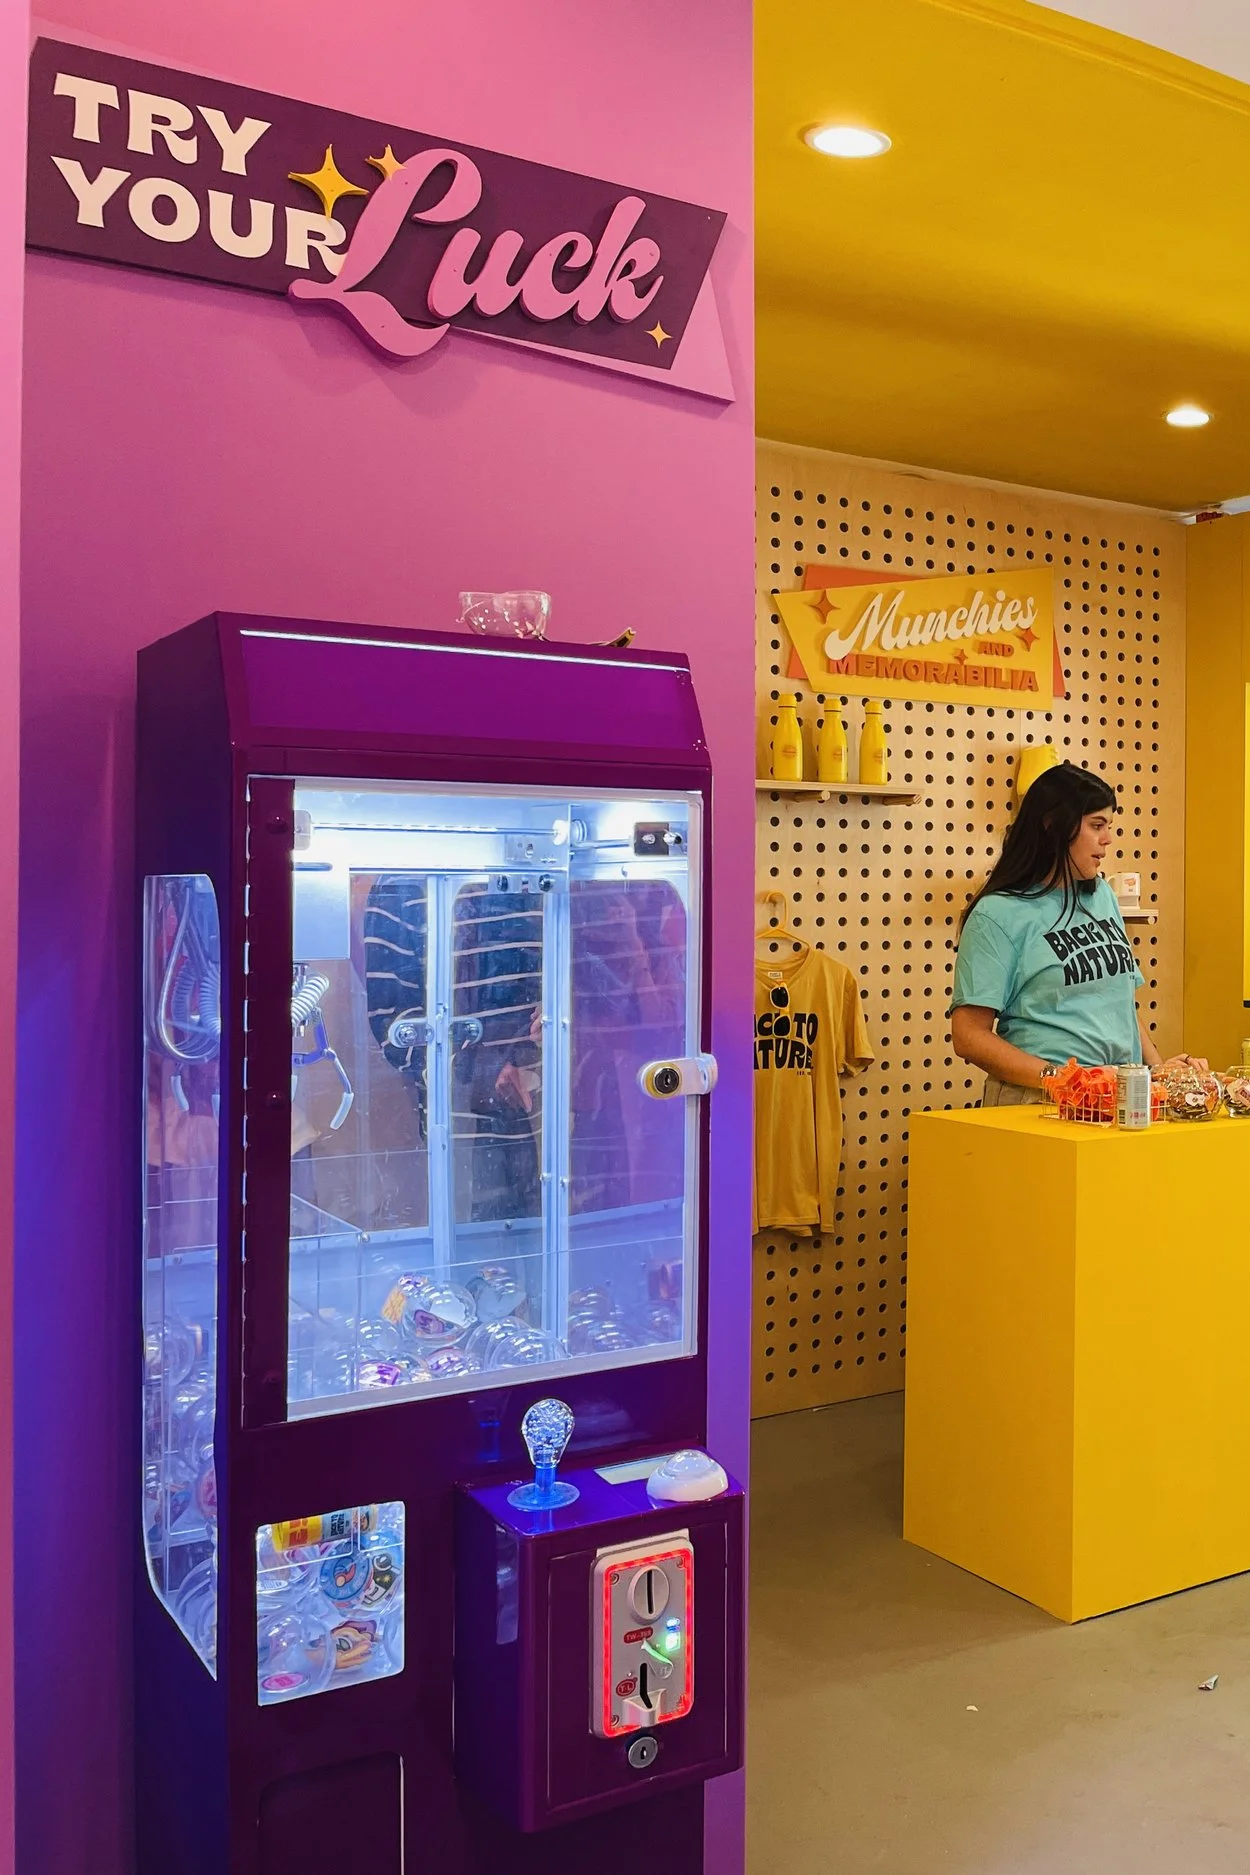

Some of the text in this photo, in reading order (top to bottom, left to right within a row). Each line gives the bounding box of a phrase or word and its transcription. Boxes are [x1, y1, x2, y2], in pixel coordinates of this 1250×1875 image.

[54, 73, 272, 176] TRY
[51, 156, 348, 275] YOUR
[287, 148, 664, 357] Luck
[824, 590, 1039, 660] Munchies
[978, 641, 1014, 657] AND
[828, 653, 1039, 692] MEMORABILIA
[1043, 922, 1105, 962] BACK
[793, 1013, 818, 1045] TO
